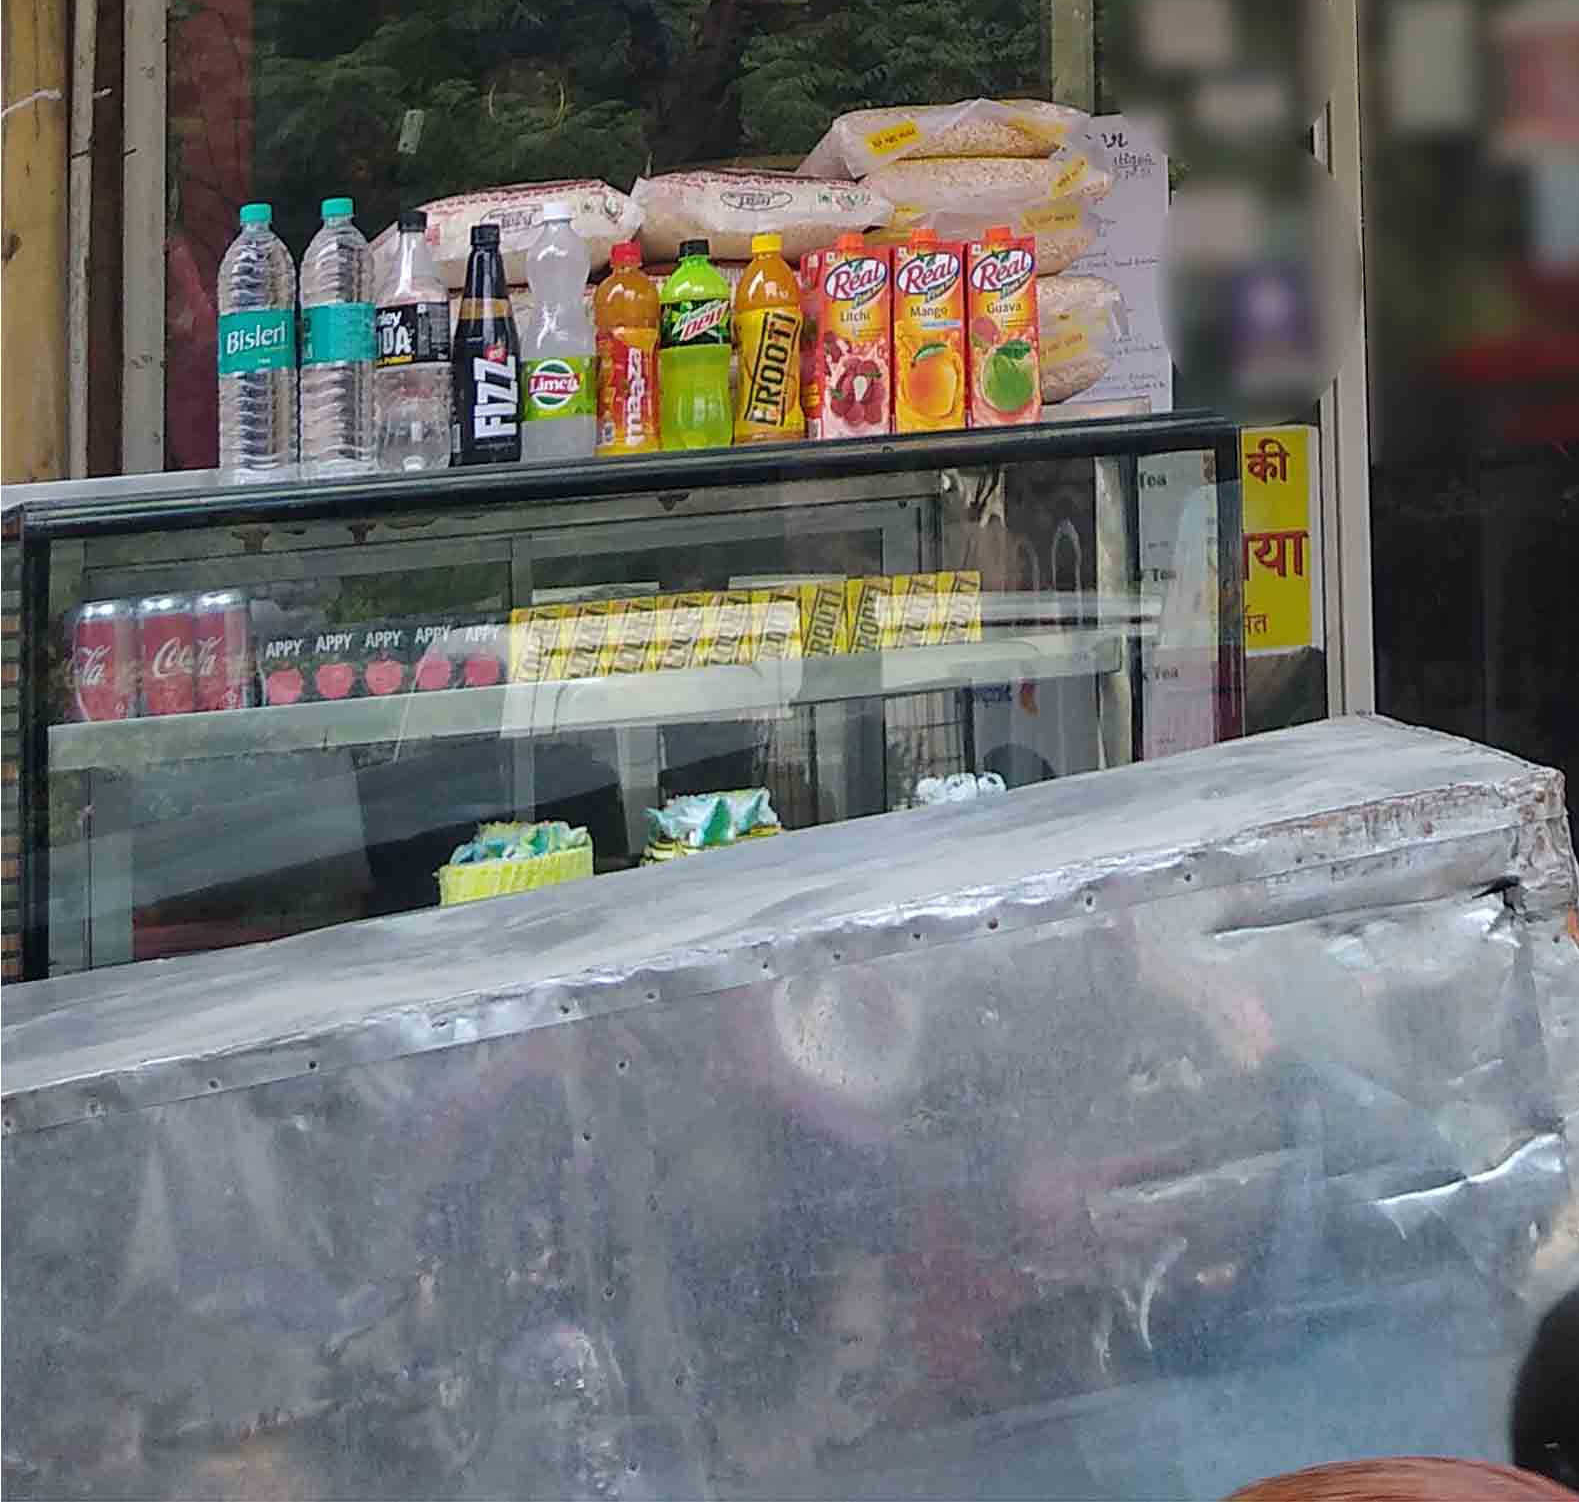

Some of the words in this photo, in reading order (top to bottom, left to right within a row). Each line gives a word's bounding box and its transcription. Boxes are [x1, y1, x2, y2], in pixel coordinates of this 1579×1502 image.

[831, 263, 880, 303] Real
[904, 254, 954, 295] Real
[978, 249, 1027, 295] Real
[910, 306, 948, 320] Mango
[226, 319, 287, 355] Bisleri
[750, 311, 798, 427] FROOTI
[473, 354, 519, 439] FIZZ
[1246, 437, 1290, 484] की
[265, 639, 304, 659] APPY
[315, 633, 353, 653] APPY
[365, 629, 402, 648] APPY
[414, 625, 450, 643] APPY
[464, 624, 499, 642] APPY
